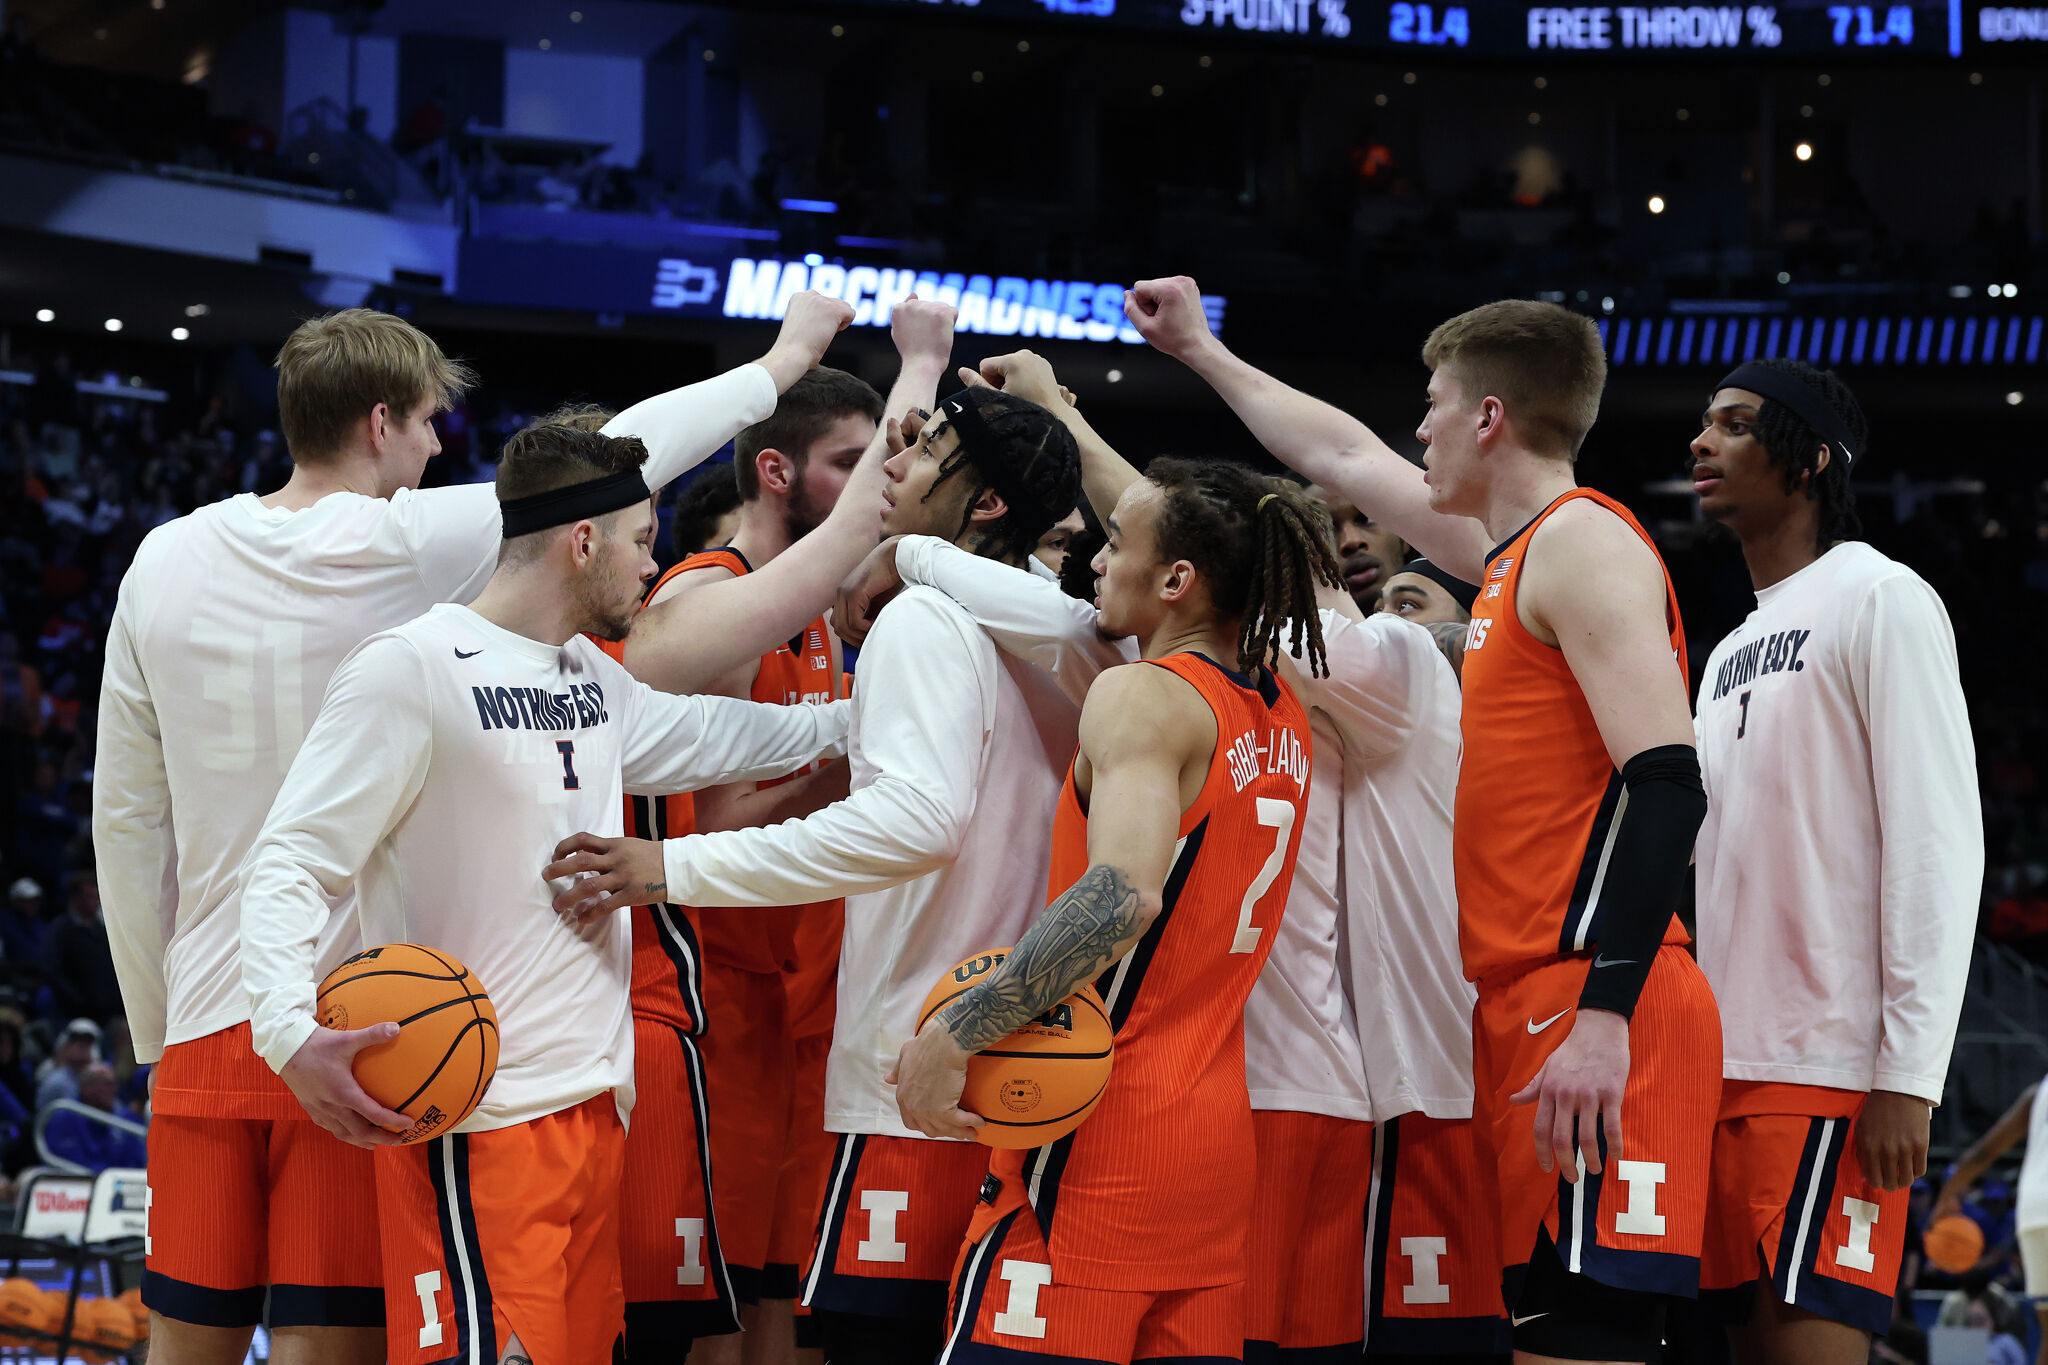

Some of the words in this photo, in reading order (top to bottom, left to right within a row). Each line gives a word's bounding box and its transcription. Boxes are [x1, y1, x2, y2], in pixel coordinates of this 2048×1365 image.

[1180, 0, 1315, 34] 3-POINT
[1317, 0, 1351, 38] %
[1389, 2, 1469, 47] 21.4
[1527, 7, 1612, 48] FREE
[1616, 6, 1742, 48] THROW
[1746, 5, 1782, 48] %
[1828, 6, 1913, 46] 71.4
[1761, 629, 1811, 676] EASY.
[555, 740, 580, 790] I
[1228, 797, 1296, 953] 2
[858, 1190, 909, 1262] I
[1615, 1160, 1666, 1235] I
[675, 1218, 705, 1285] I
[1400, 1236, 1450, 1304] I
[1835, 1196, 1880, 1273] I
[414, 1270, 443, 1348] I
[993, 1259, 1052, 1339] I
